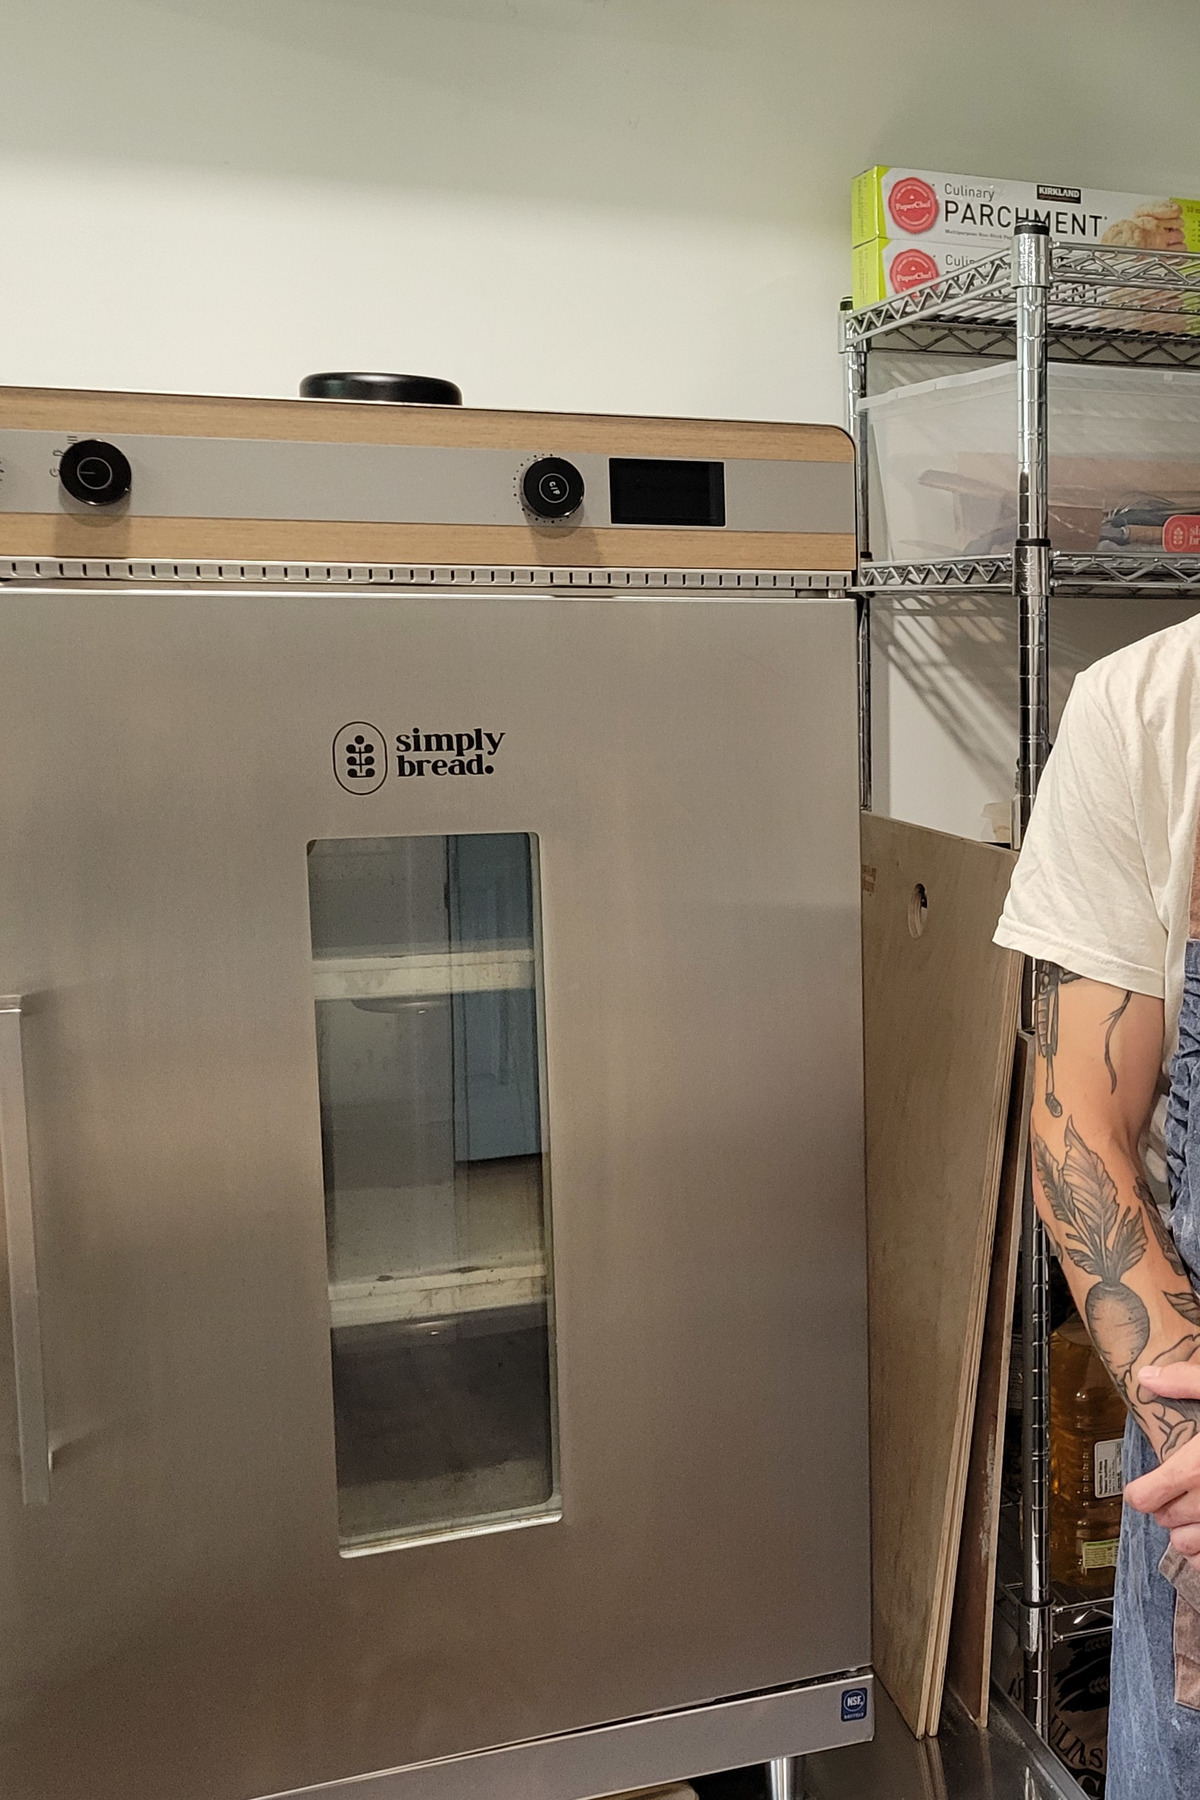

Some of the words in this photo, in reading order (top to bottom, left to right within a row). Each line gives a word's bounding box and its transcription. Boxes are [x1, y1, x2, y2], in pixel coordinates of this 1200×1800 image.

[944, 183, 996, 202] Culinary
[1038, 186, 1081, 199] KIRKLAND
[395, 727, 506, 757] simply
[396, 753, 495, 778] bread.
[847, 1695, 862, 1707] NSF
